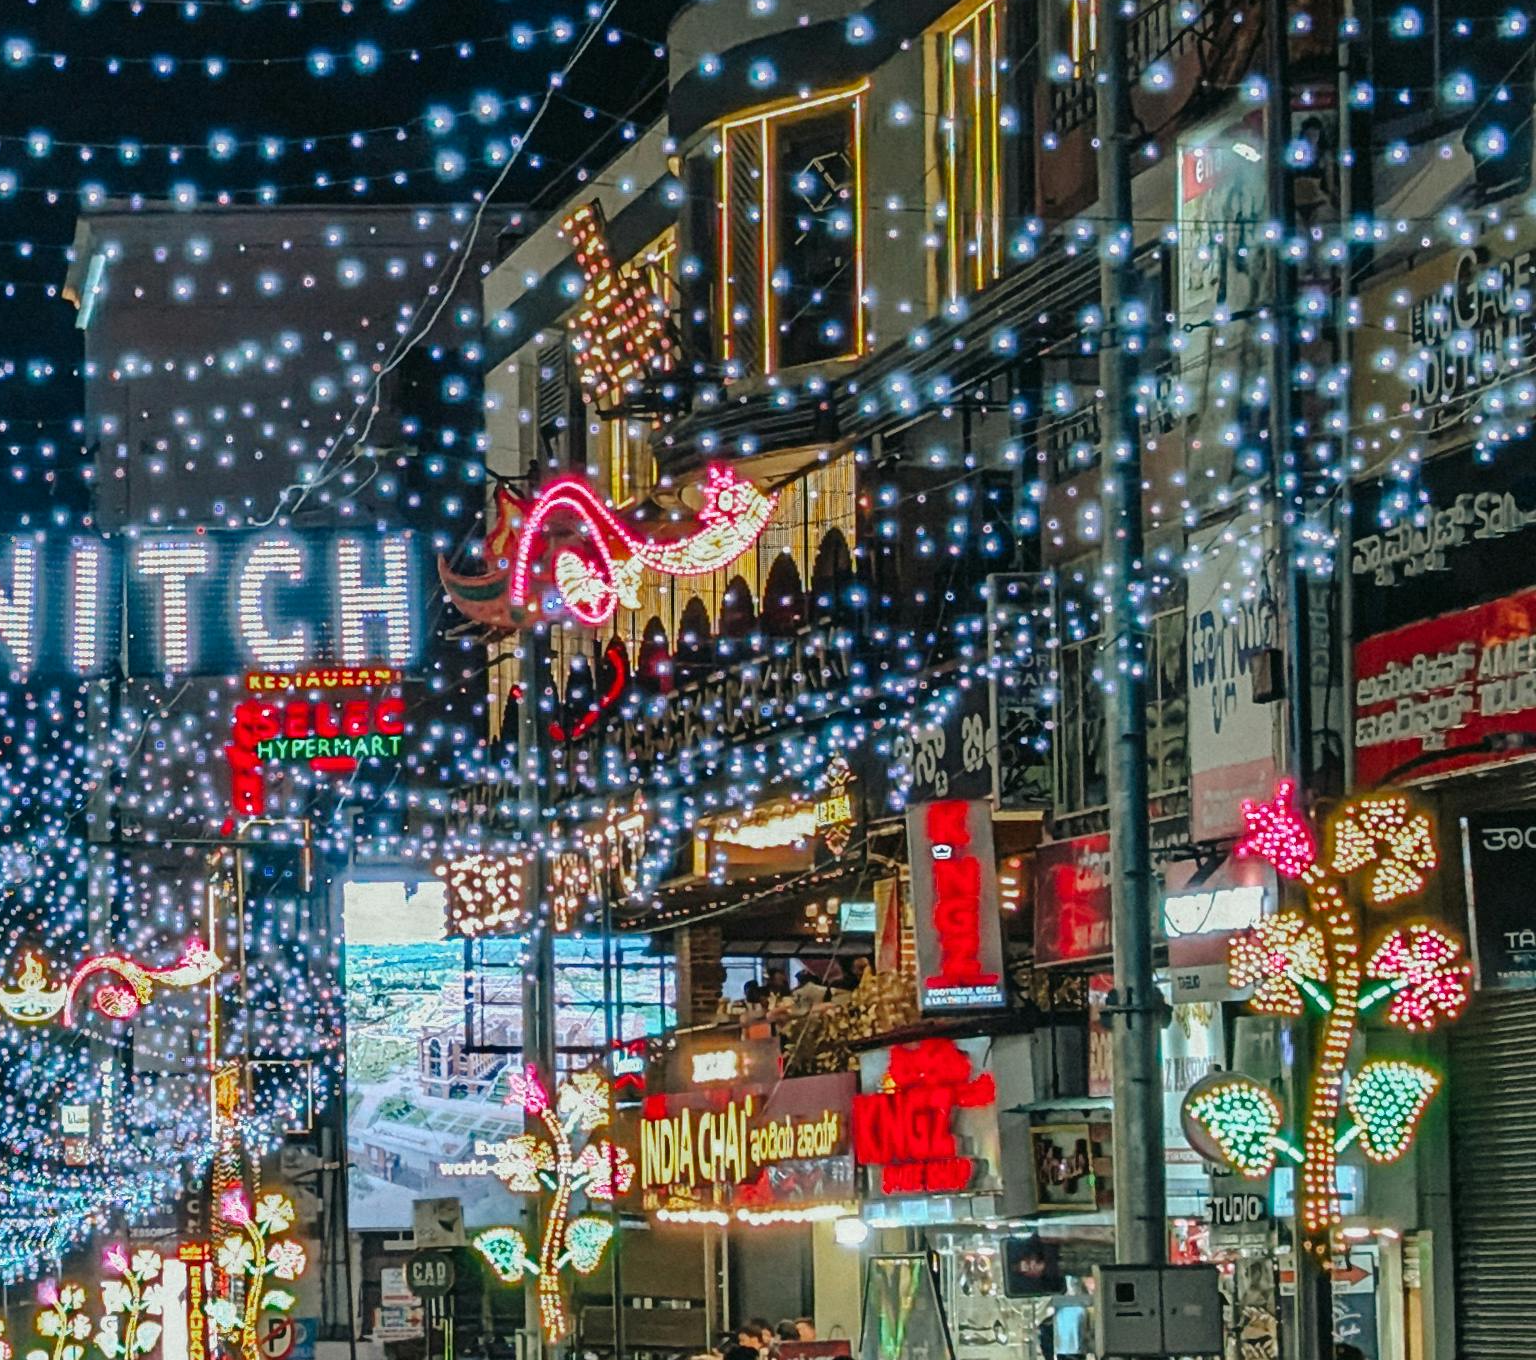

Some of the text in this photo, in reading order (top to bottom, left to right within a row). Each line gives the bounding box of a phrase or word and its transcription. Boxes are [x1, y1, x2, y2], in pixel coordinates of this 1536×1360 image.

[257, 735, 402, 761] HYPERMART
[641, 1100, 748, 1189] INDIA CHAI
[1202, 1193, 1261, 1223] STUDIO
